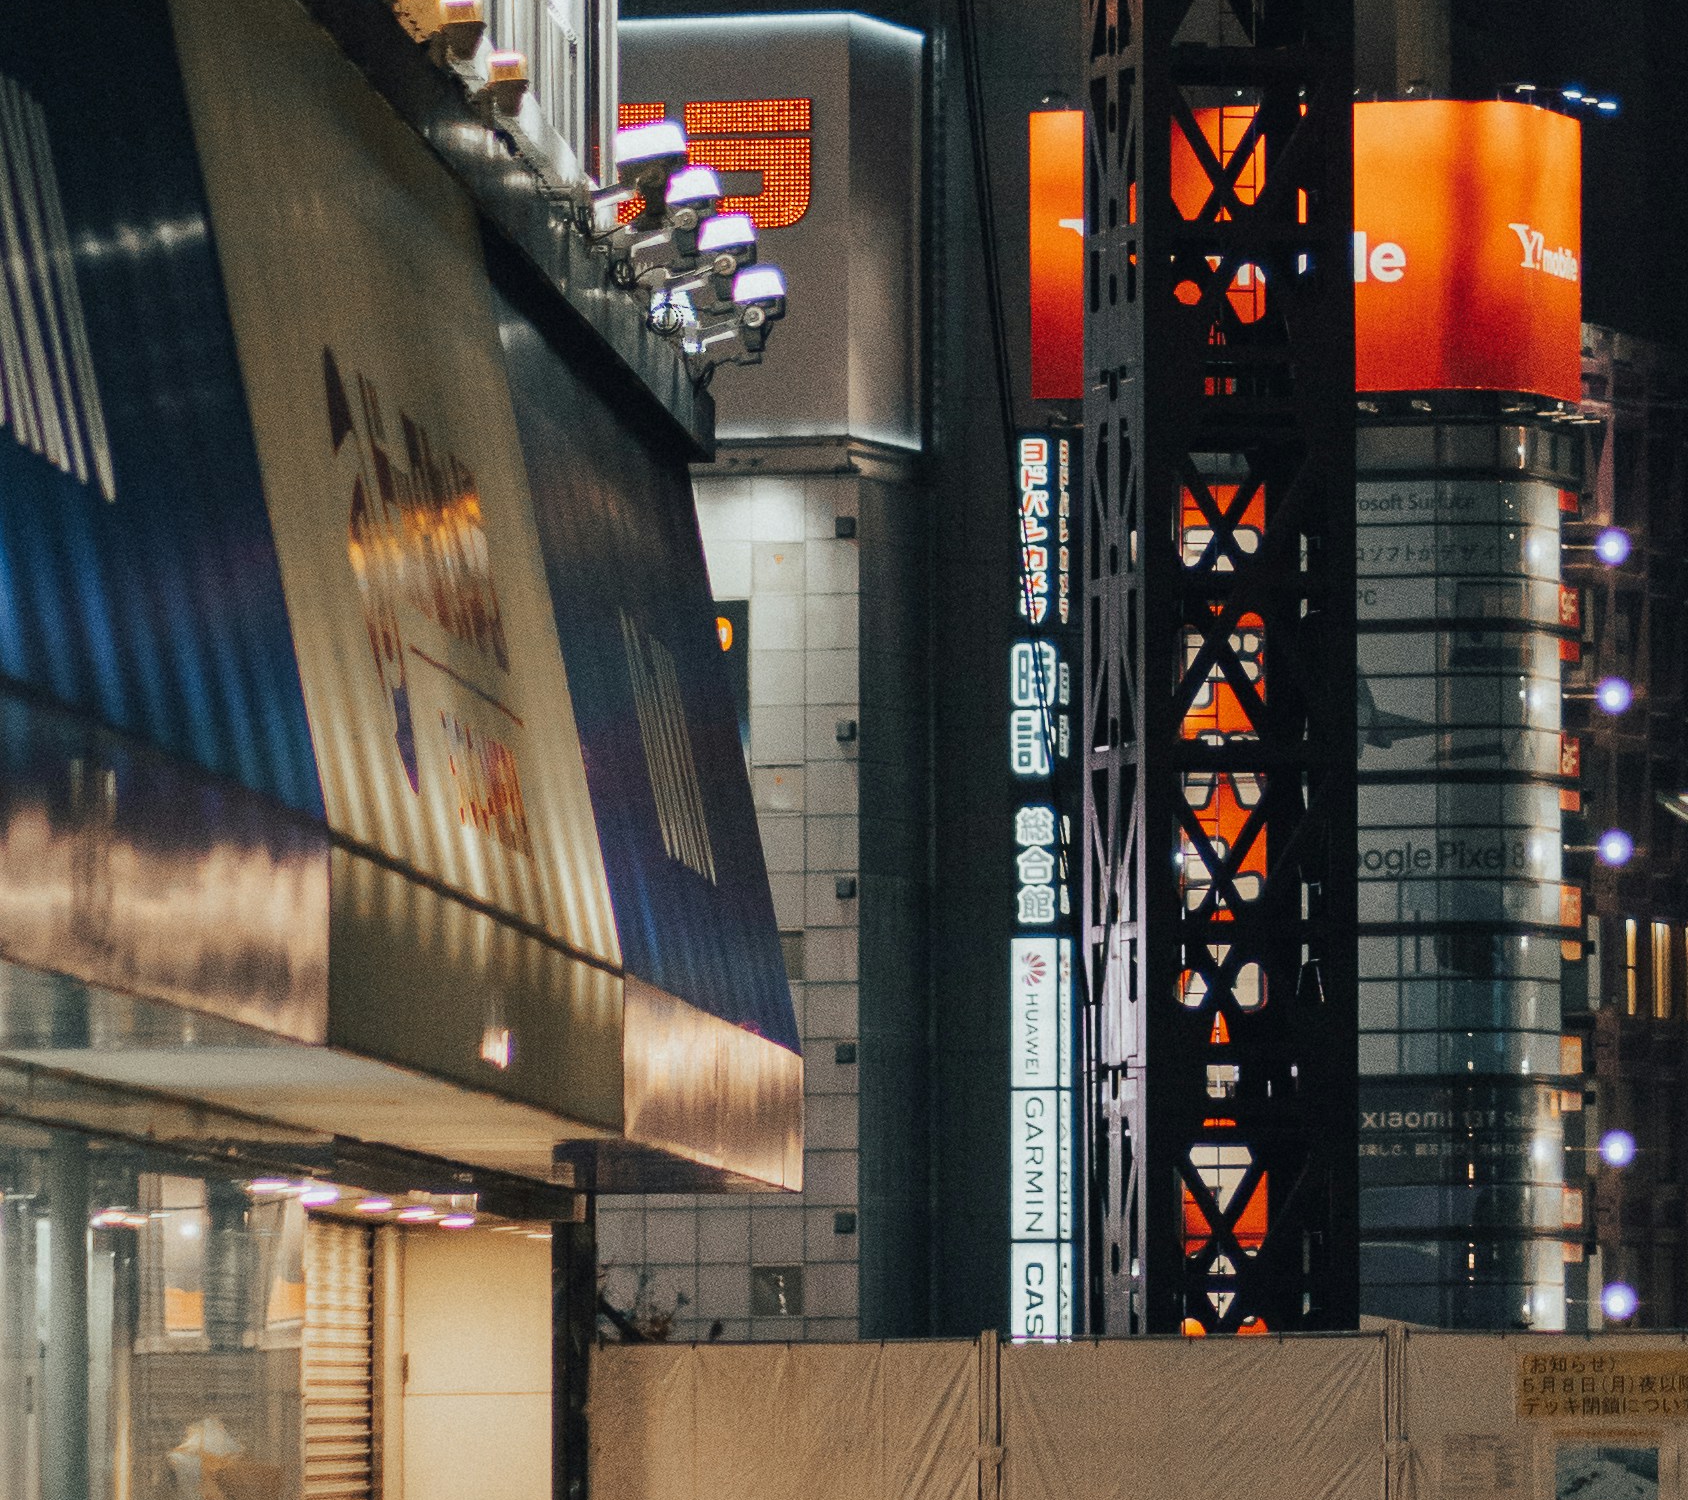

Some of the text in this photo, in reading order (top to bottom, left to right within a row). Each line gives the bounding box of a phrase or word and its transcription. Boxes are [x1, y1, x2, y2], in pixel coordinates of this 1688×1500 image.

[1016, 807, 1054, 923] 総合館
[1025, 992, 1039, 1077] HUAWEI
[1025, 1097, 1044, 1232] GARMIN
